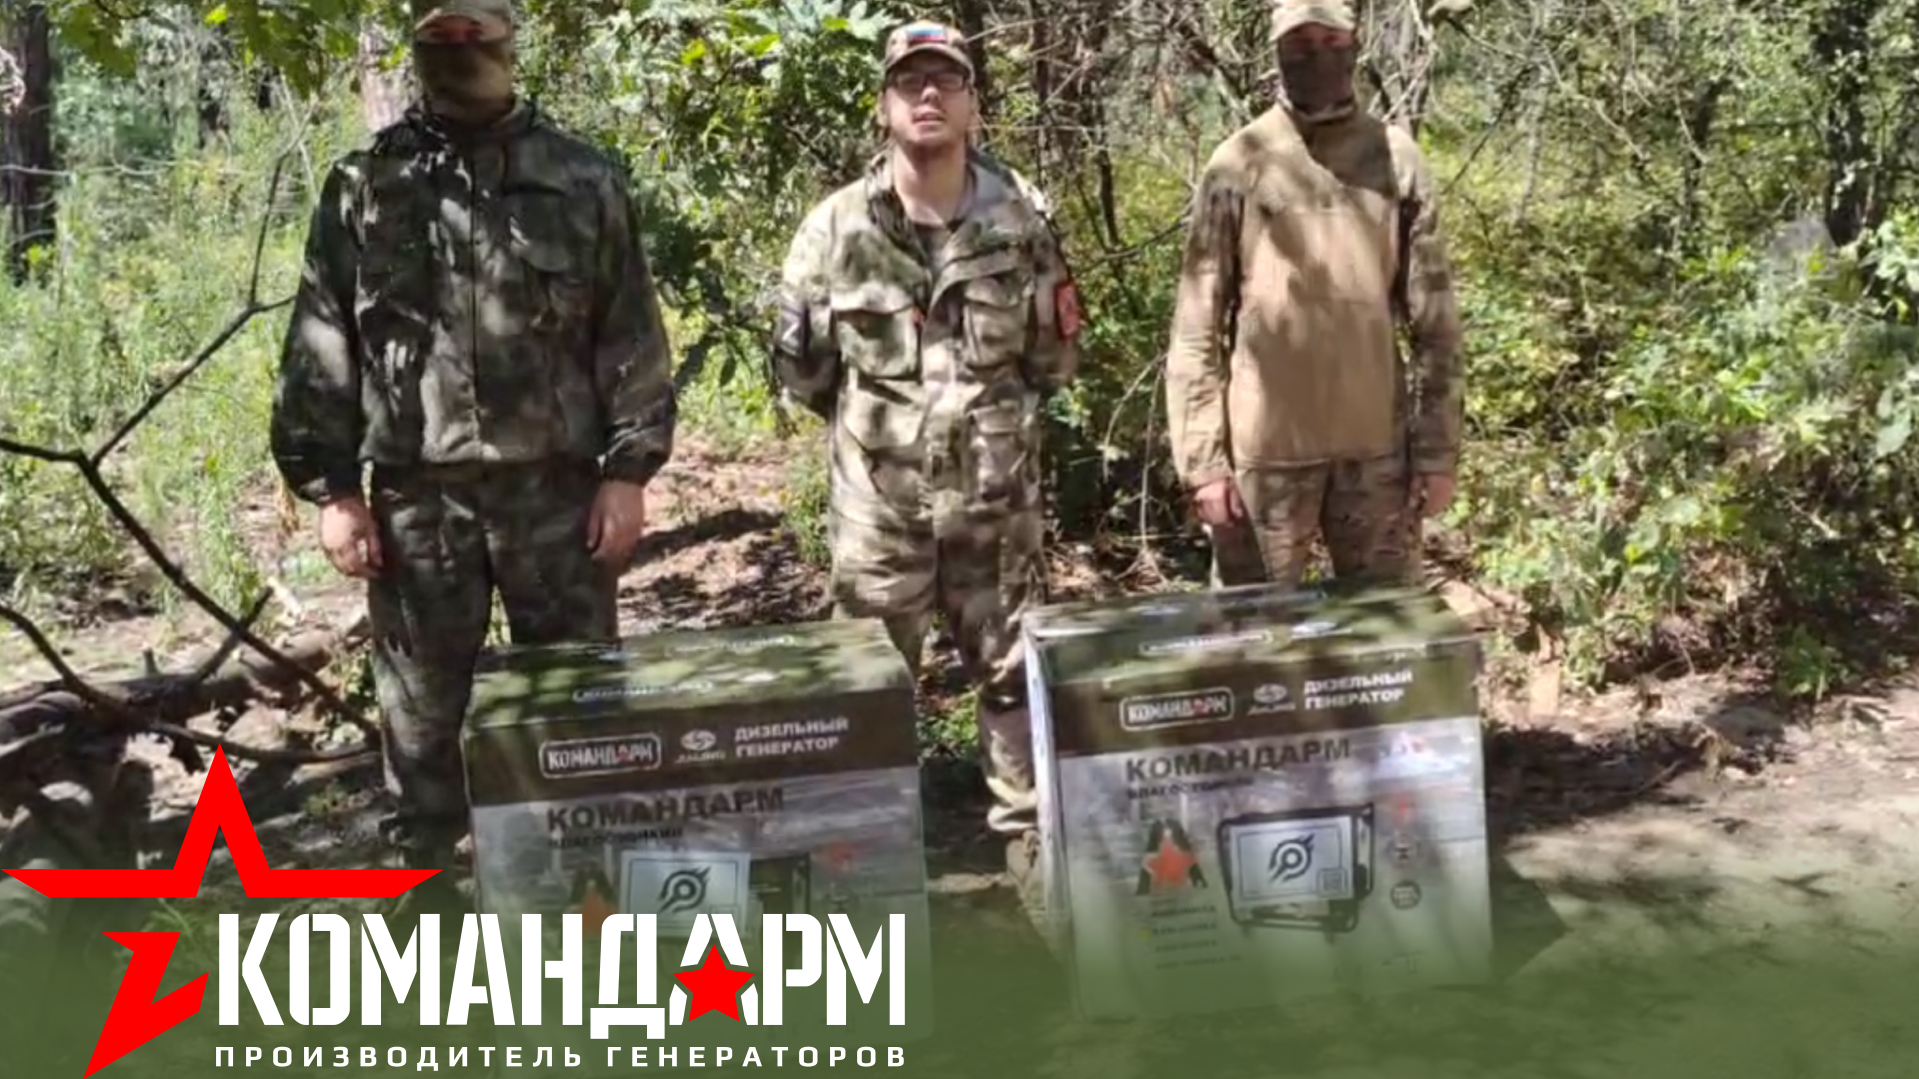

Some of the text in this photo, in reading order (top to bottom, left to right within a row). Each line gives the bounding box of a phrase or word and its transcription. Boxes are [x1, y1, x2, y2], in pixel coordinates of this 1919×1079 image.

[1304, 669, 1413, 694] ДИЗЕЛЬНЫЙ
[1305, 688, 1405, 710] ГЕНЕРАТОР
[735, 716, 849, 742] ДИЗЕЛЬНЫЙ
[547, 743, 654, 770] КОМАНДАРМ
[735, 737, 840, 758] ГЕНЕРАТОР
[1126, 738, 1350, 782] КОМАНДАРМ
[547, 787, 784, 832] КОМАНДАРМ
